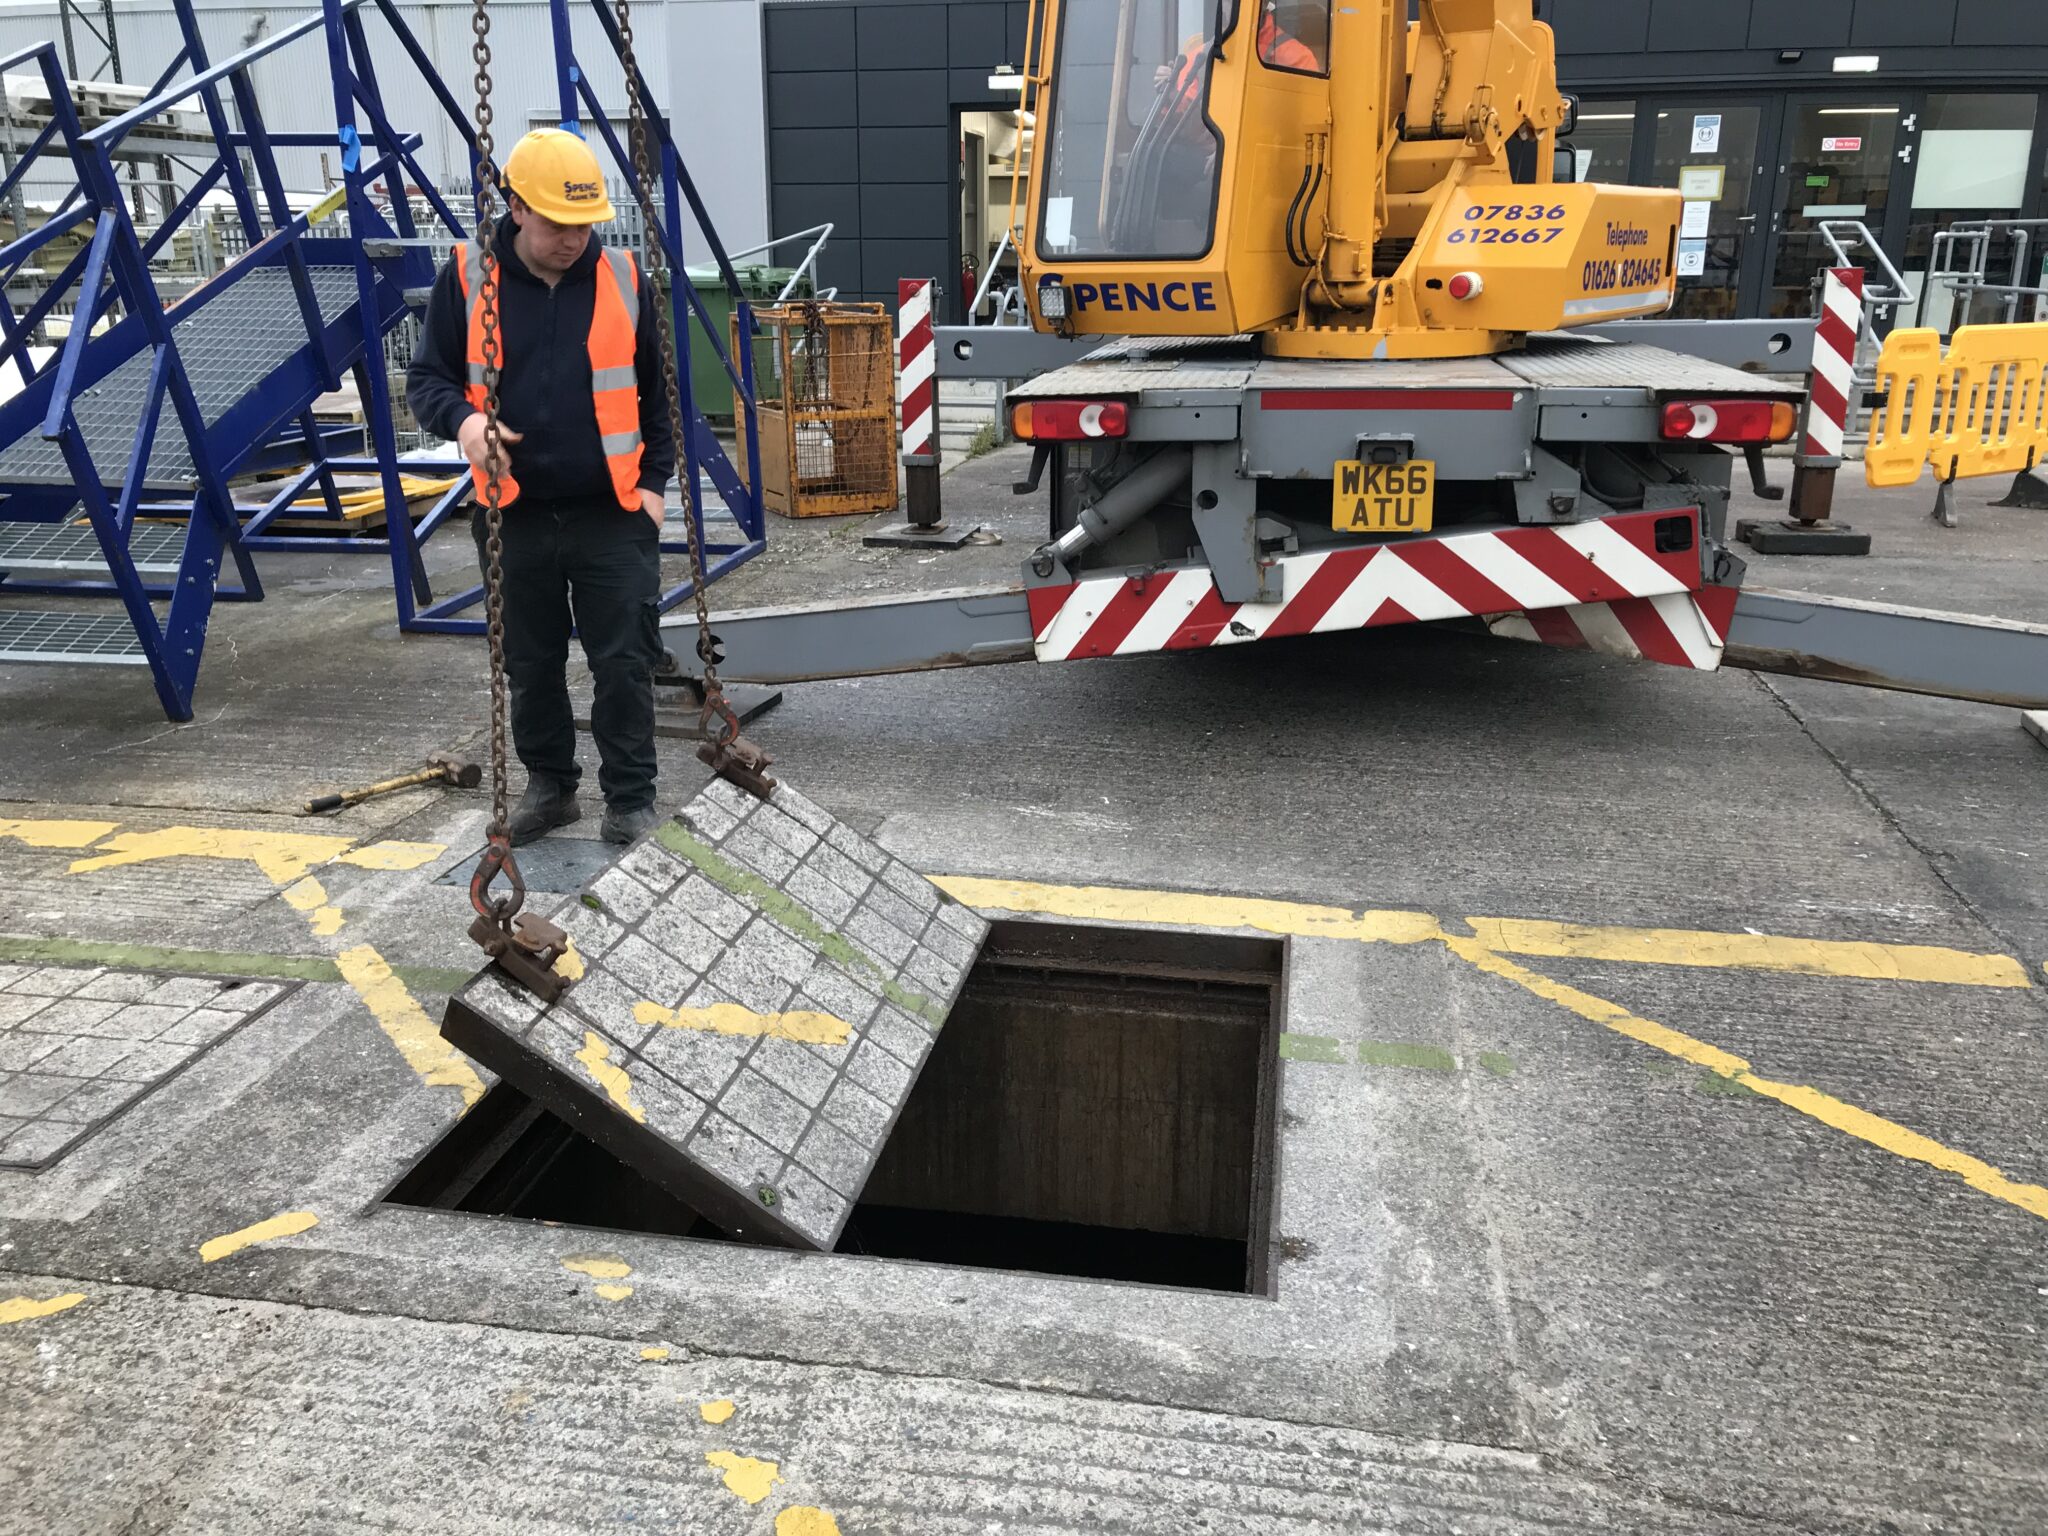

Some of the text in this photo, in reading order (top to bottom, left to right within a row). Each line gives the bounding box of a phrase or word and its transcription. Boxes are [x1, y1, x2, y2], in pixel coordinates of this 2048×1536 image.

[1464, 204, 1566, 221] 07836
[1447, 227, 1565, 244] 612667
[1606, 221, 1648, 252] Telephone
[1582, 257, 1662, 292] 01626 824645
[1342, 465, 1428, 495] WK66
[1351, 497, 1415, 527] ATU
